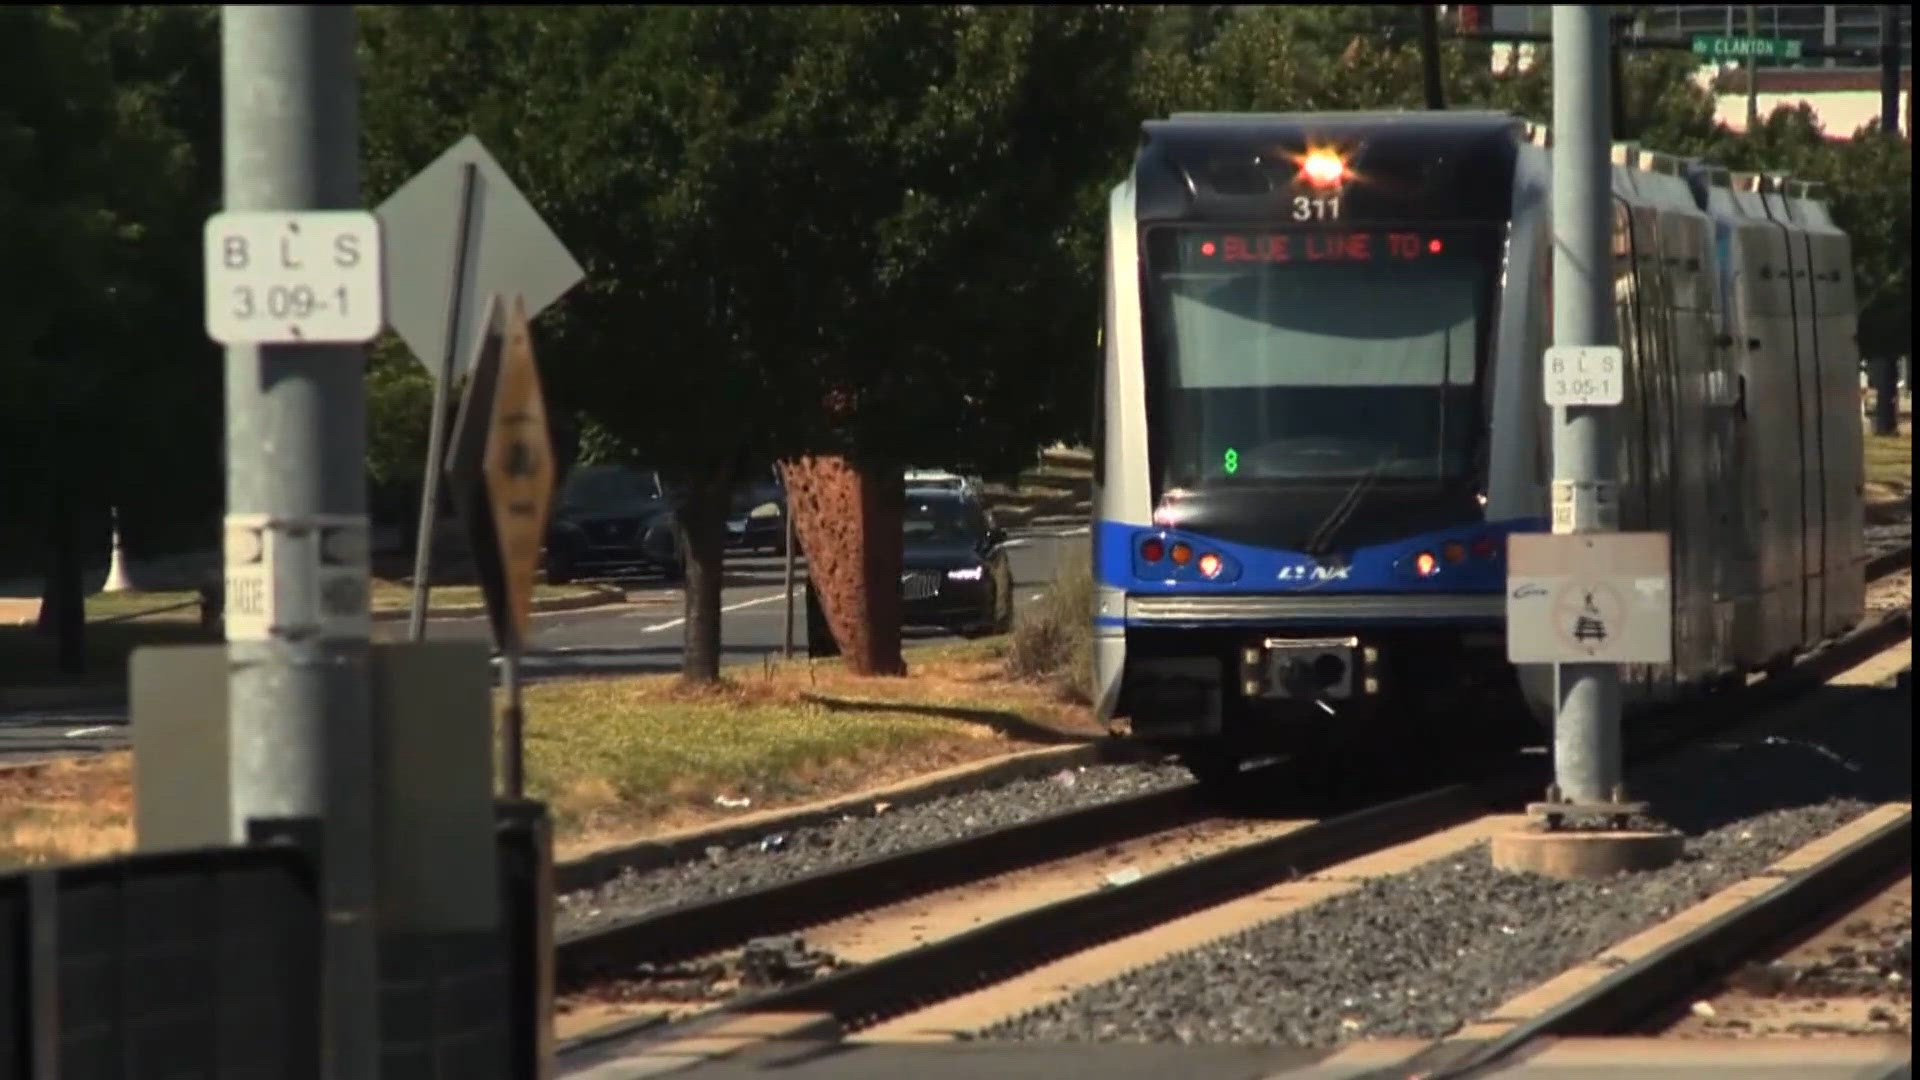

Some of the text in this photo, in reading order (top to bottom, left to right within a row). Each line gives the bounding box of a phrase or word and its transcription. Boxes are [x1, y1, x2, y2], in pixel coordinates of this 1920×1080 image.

[1714, 38, 1774, 56] CLANTON
[1292, 196, 1340, 222] 311
[1222, 232, 1422, 263] BLUE LINE TO
[231, 284, 348, 320] 3.09-1
[1224, 447, 1238, 475] 8
